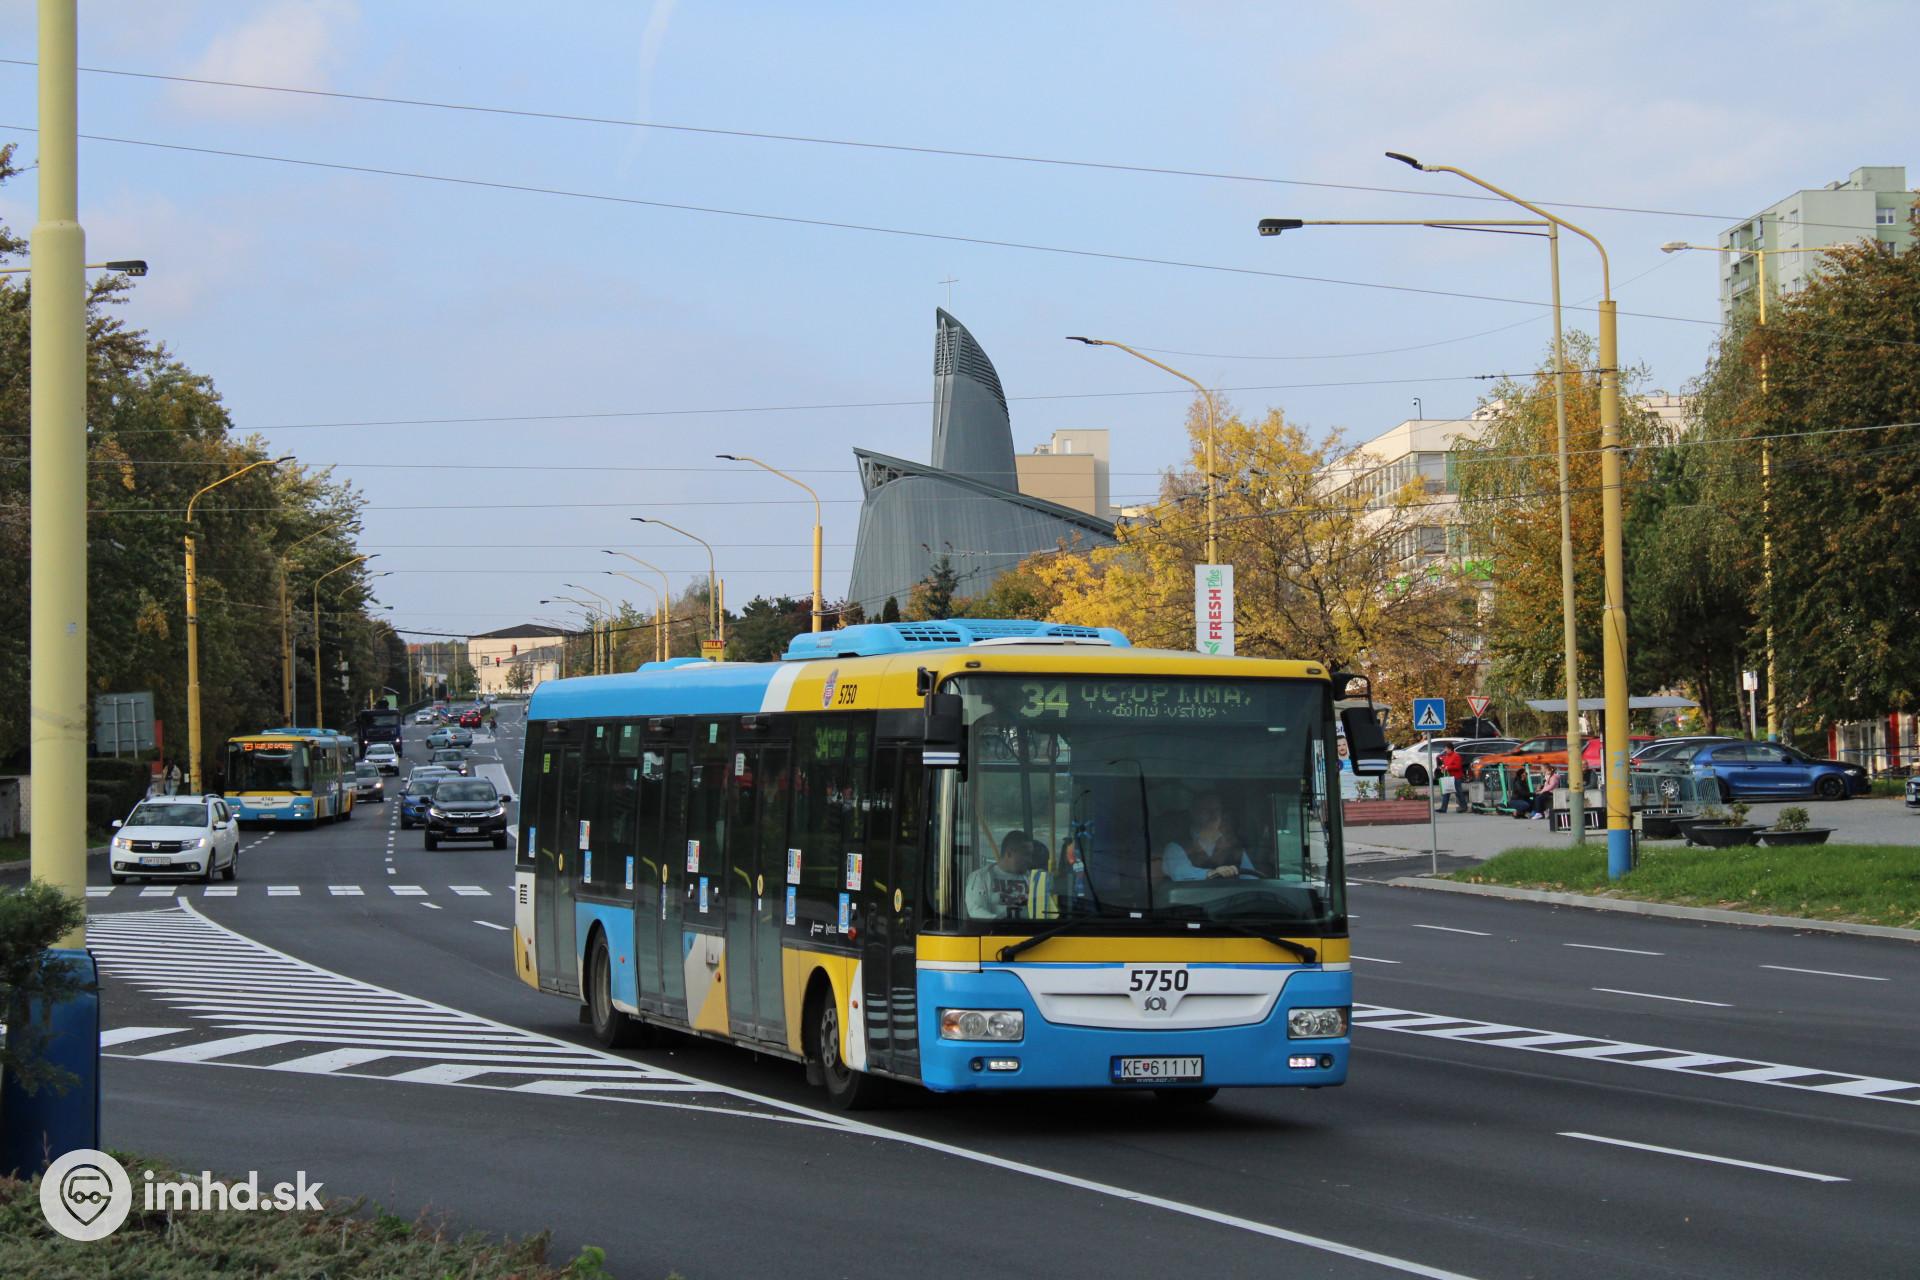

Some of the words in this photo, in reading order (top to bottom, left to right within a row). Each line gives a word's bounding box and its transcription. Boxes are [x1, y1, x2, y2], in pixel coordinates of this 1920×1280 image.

[1209, 589, 1222, 640] FRESH
[838, 684, 858, 705] 5750
[1020, 683, 1069, 718] 34
[1129, 969, 1189, 992] 5750
[1123, 1060, 1142, 1076] KE
